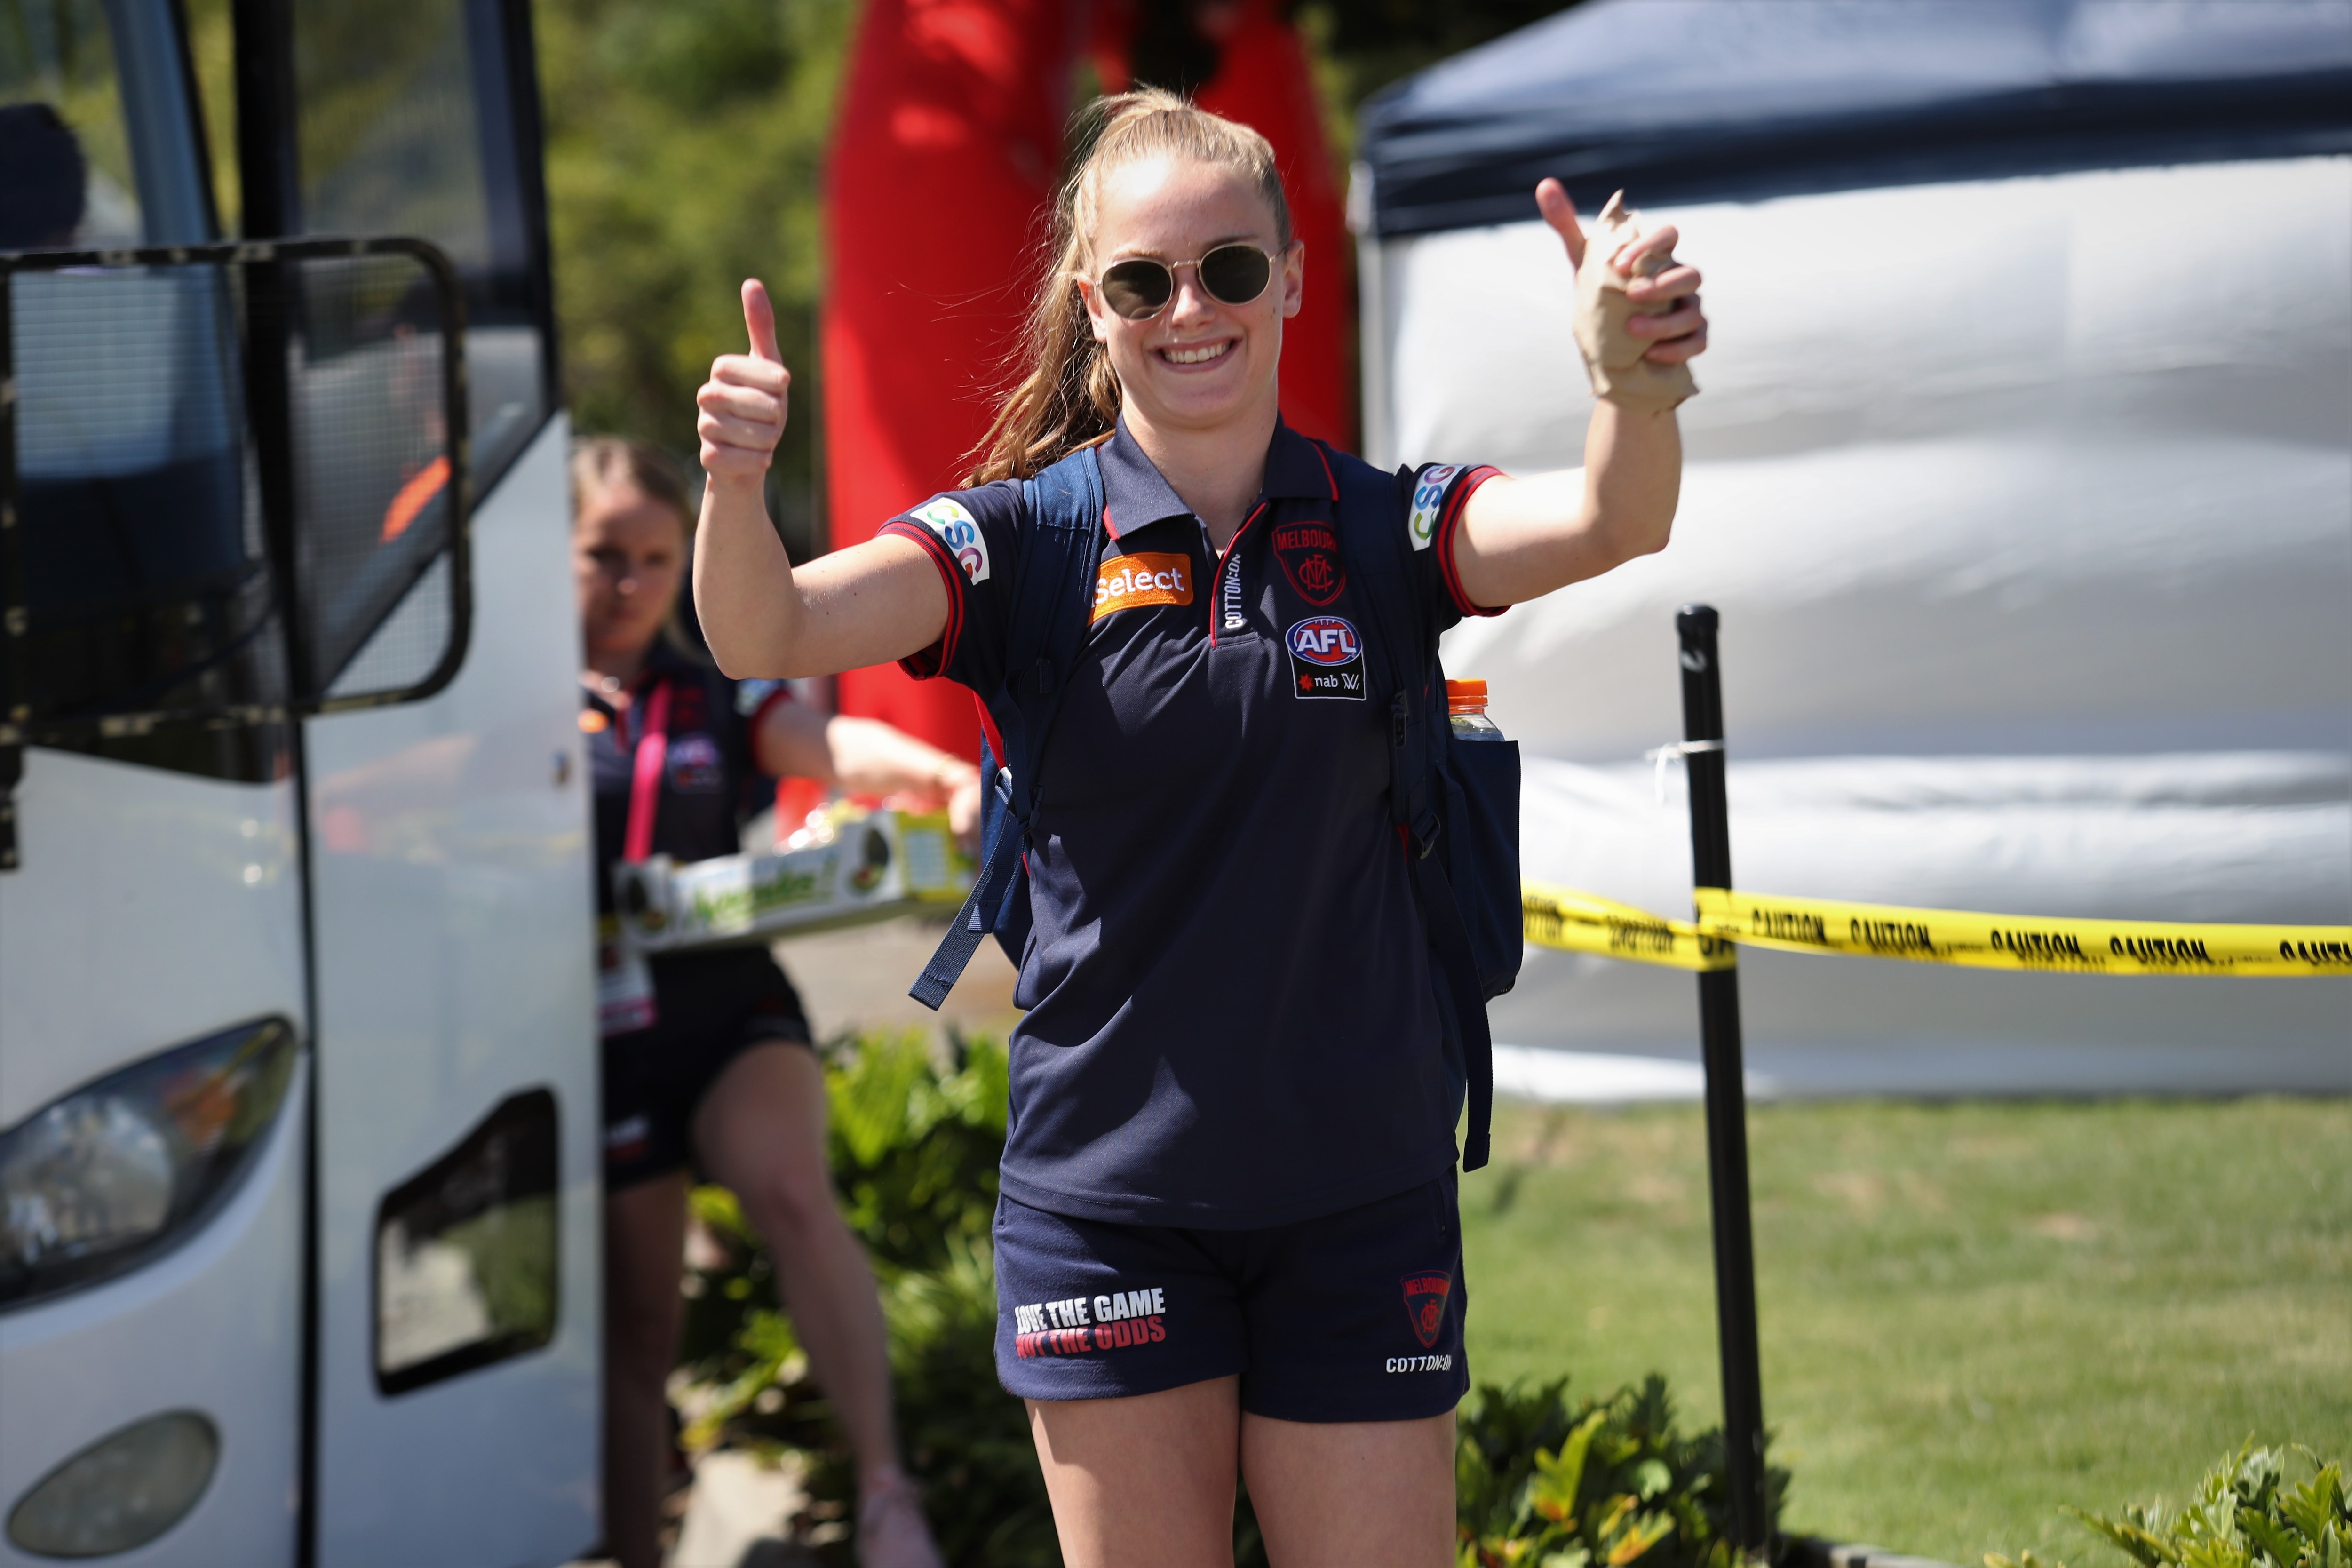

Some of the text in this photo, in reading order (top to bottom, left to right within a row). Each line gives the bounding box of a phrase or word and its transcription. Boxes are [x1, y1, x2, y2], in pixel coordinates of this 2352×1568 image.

[1413, 466, 1455, 540] CSG
[927, 505, 983, 579] CSG
[1277, 529, 1338, 554] MELBOUR
[1091, 568, 1184, 607] Select
[1296, 629, 1357, 653] AFL
[1314, 675, 1338, 687] nab
[1045, 1297, 1091, 1329] THE
[1093, 1288, 1166, 1323] GAME
[1048, 1326, 1092, 1355] THE
[1095, 1315, 1166, 1350] ODDS
